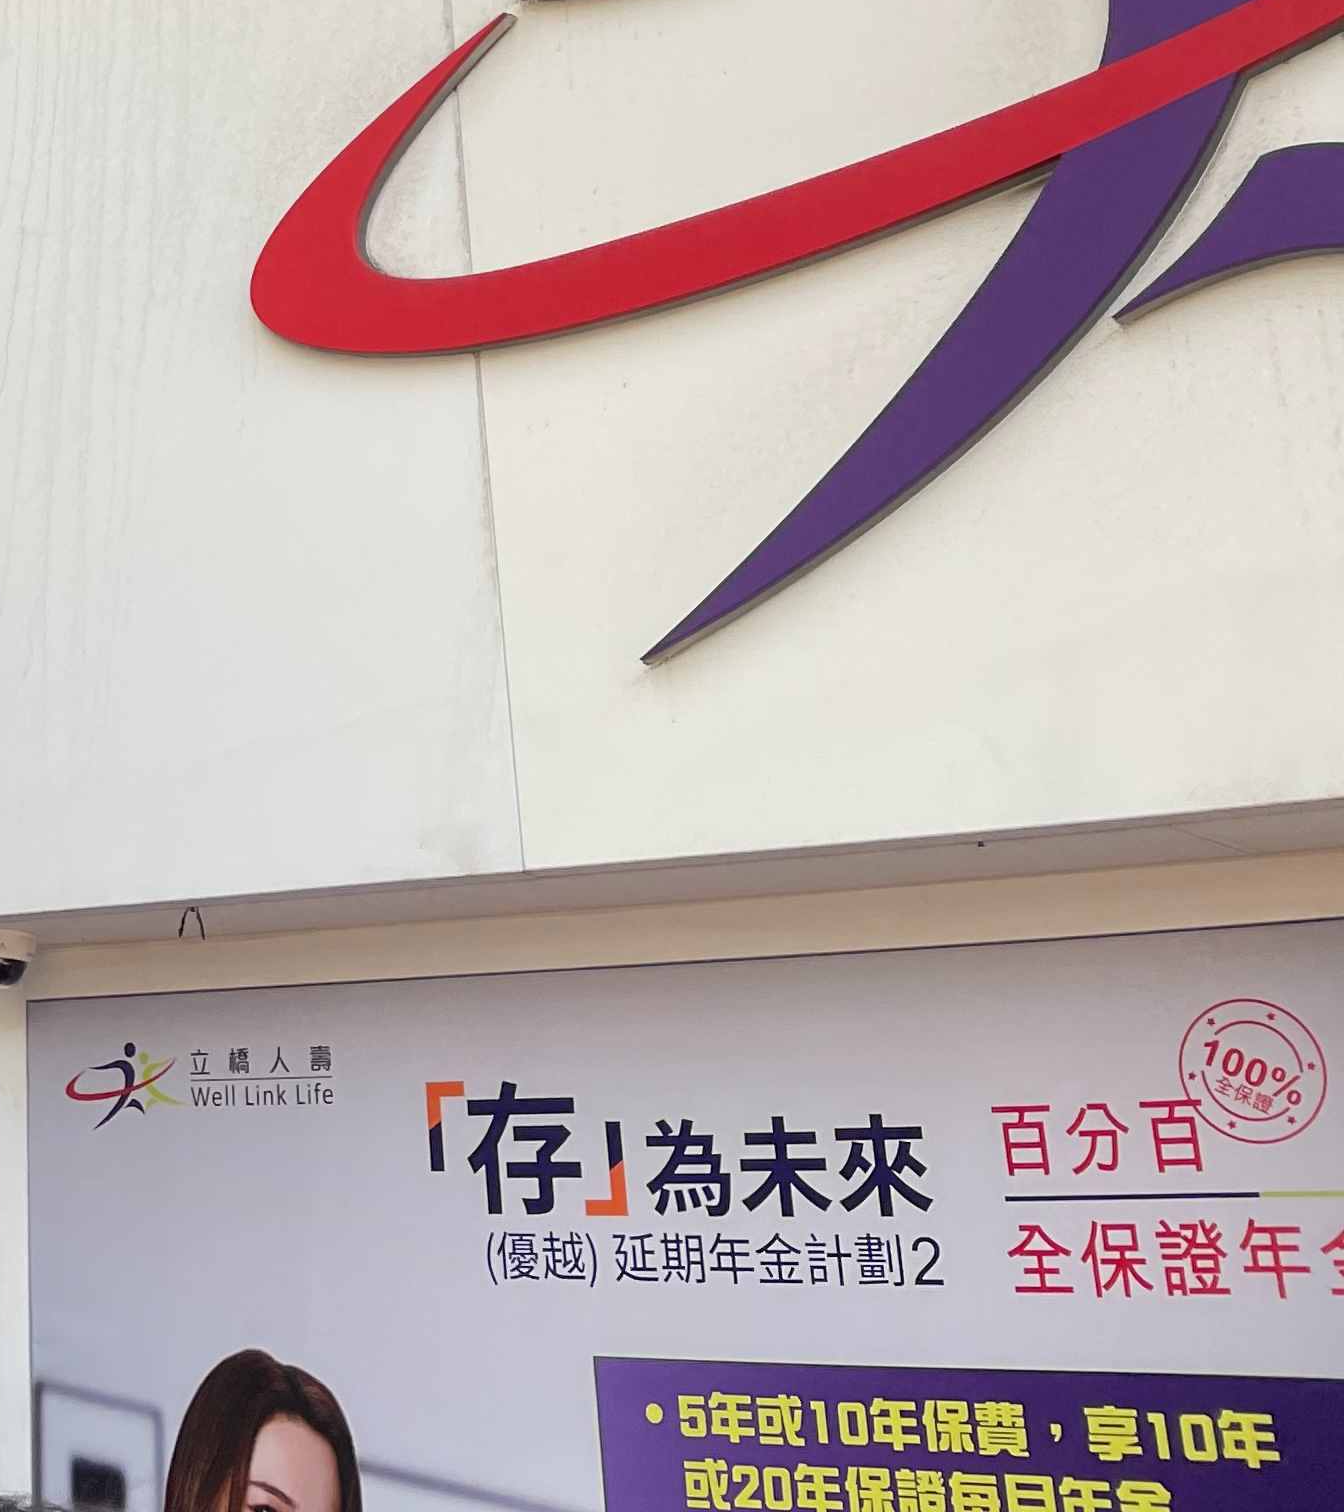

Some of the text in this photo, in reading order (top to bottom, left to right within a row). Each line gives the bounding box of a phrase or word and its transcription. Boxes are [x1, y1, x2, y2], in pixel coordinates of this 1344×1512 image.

[189, 1045, 333, 1076] 立橋人壽
[1203, 1039, 1302, 1106] 100%
[190, 1082, 334, 1107] Well Link Life
[1214, 1075, 1274, 1116] 全保證
[990, 1098, 1205, 1177] 百分百
